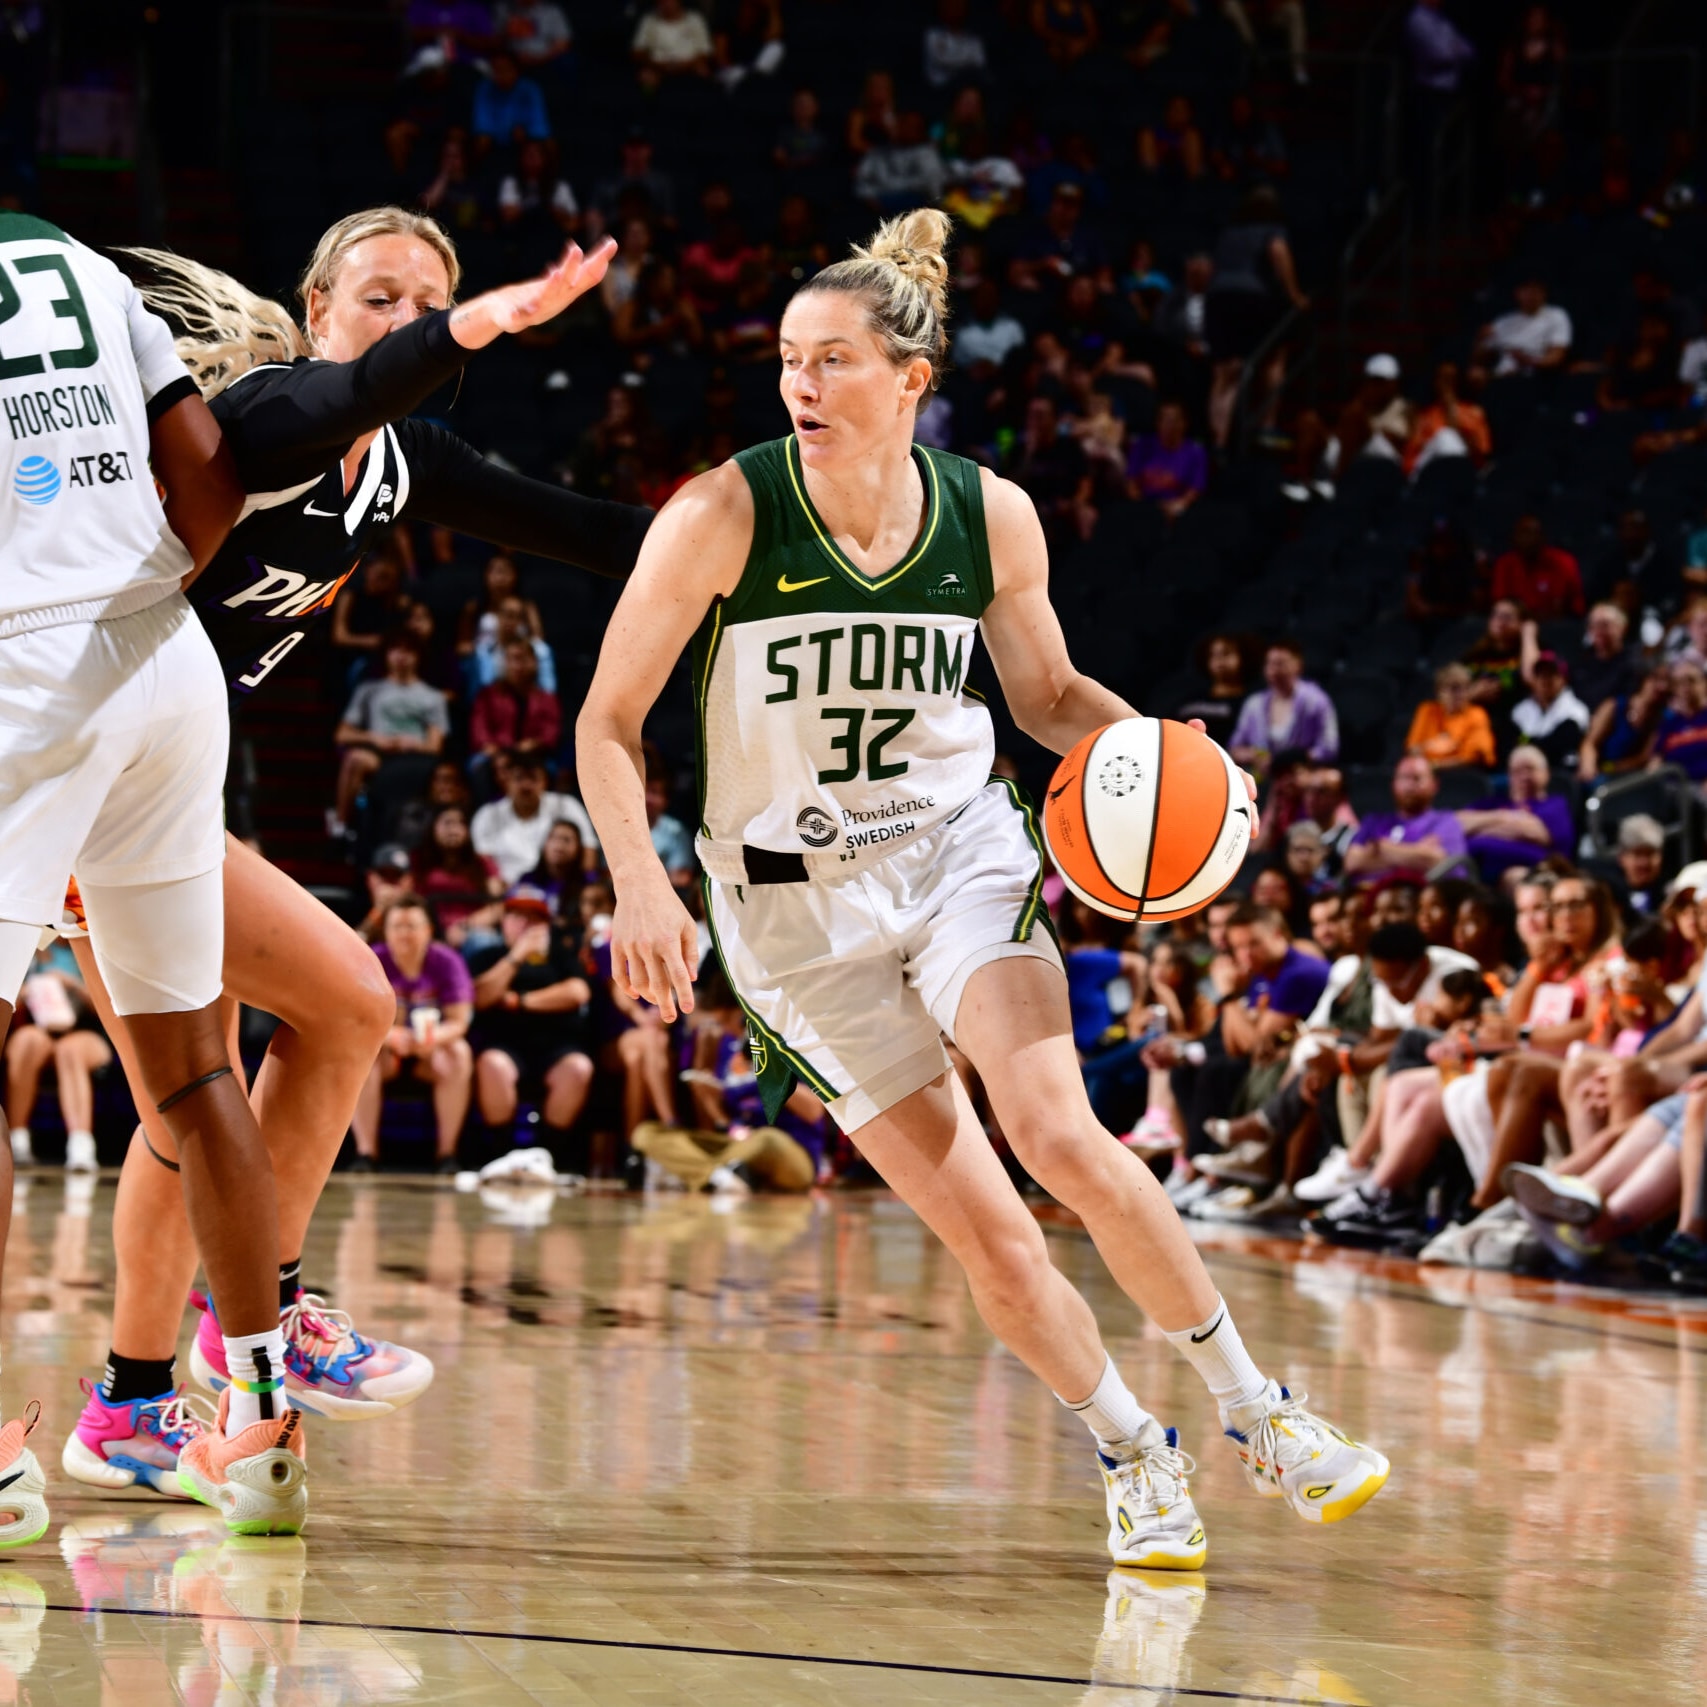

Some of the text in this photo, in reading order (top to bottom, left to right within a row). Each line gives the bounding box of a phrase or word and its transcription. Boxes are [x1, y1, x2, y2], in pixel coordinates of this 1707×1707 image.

[0, 253, 100, 380] 23
[4, 384, 117, 440] HORSTON
[69, 451, 134, 488] AT&T
[927, 587, 967, 596] SYMETRA
[237, 631, 305, 688] 9
[765, 622, 963, 704] STORM
[817, 707, 916, 786] 32
[841, 795, 936, 827] Providence
[845, 820, 916, 849] SWEDISH
